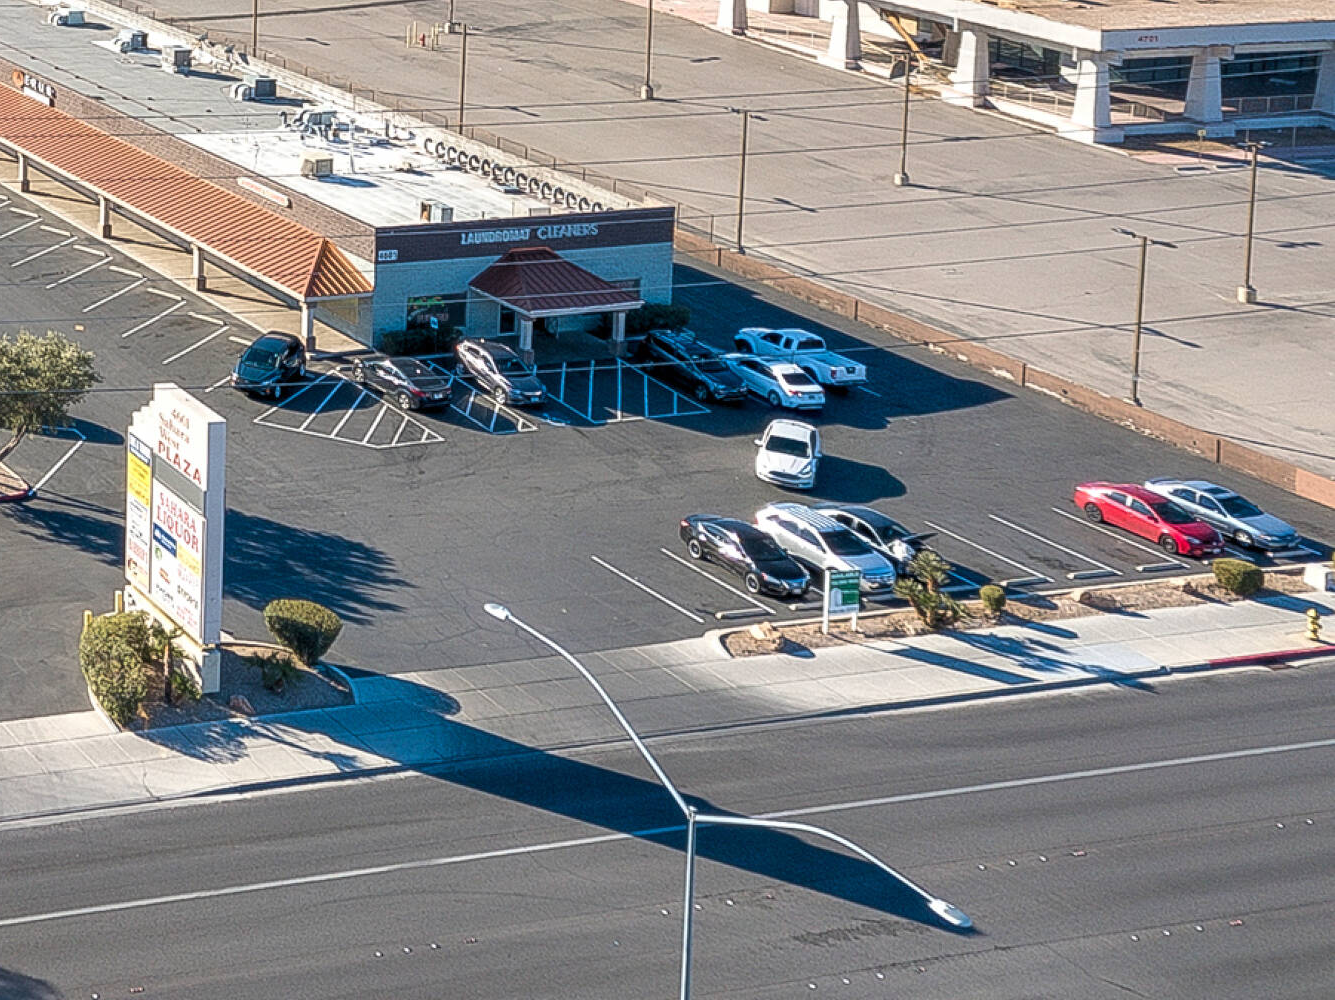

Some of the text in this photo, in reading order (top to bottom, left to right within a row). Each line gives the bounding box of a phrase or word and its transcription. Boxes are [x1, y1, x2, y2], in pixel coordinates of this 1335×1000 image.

[461, 223, 599, 245] LAUNDROMAT CLEANERS
[158, 440, 203, 485] PLAZA
[157, 504, 199, 553] LIQUOR
[159, 491, 197, 533] SAHARA
